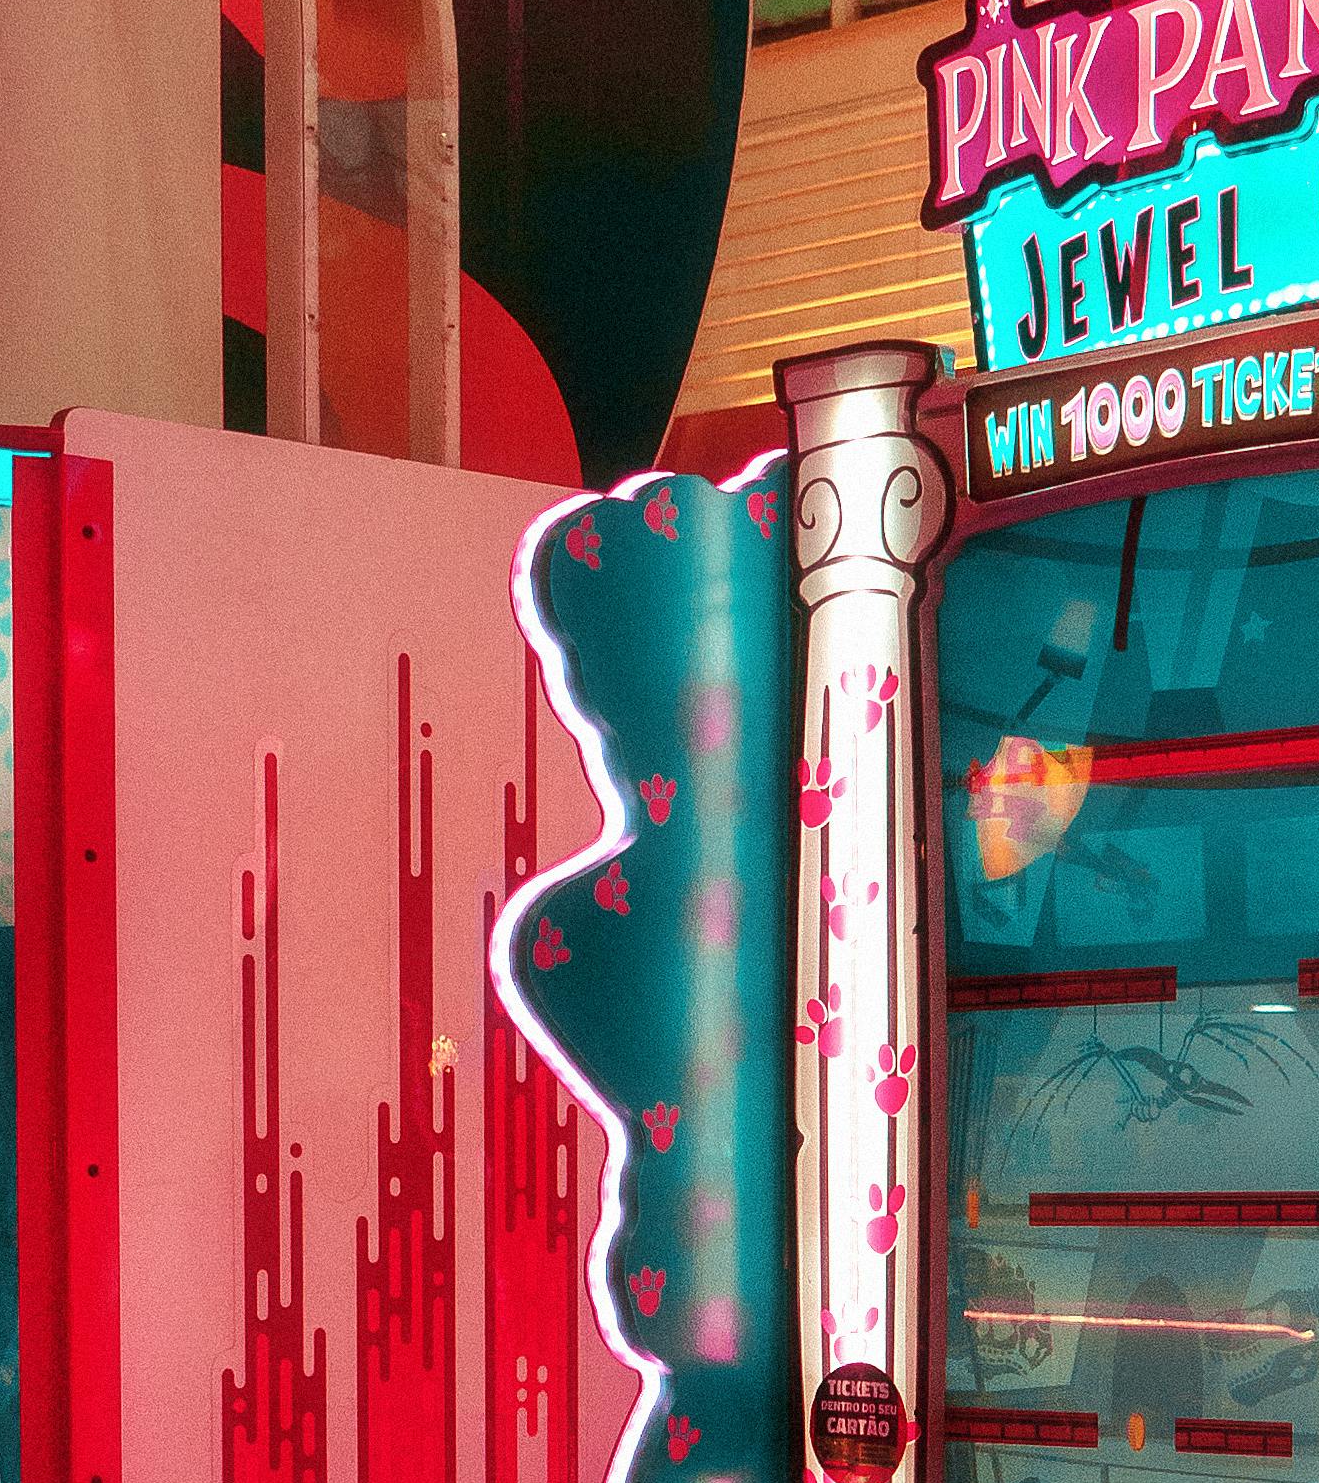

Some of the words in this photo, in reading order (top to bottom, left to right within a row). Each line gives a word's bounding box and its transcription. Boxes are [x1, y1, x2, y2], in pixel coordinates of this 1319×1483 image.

[938, 20, 1119, 203] PINK
[1016, 190, 1253, 362] JEWEL
[985, 399, 1054, 476] WIN
[1062, 369, 1187, 461] 1000
[822, 1401, 859, 1412] DENTRO
[862, 1402, 875, 1413] DO
[879, 1405, 897, 1415] SEU
[828, 1380, 889, 1398] TICKETS
[828, 1416, 889, 1436] CARTÃO
